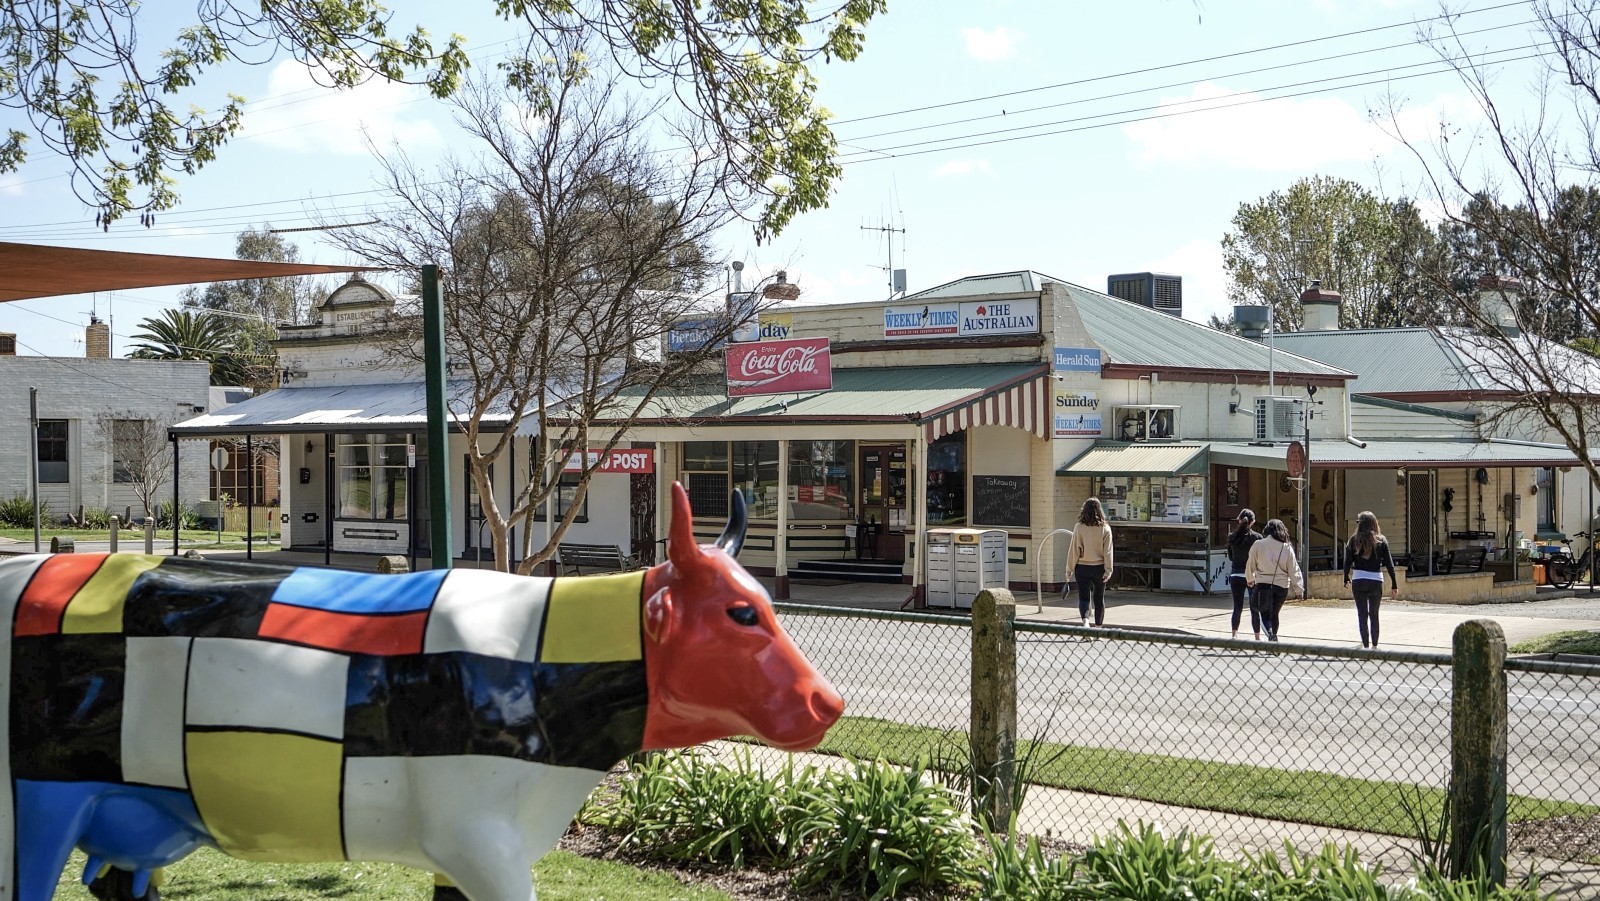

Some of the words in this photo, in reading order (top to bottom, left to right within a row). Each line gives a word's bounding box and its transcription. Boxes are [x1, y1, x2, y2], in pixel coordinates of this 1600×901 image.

[988, 304, 1011, 316] THE
[885, 312, 922, 328] WEEKLY
[929, 311, 958, 326] TIMES
[963, 315, 1034, 331] AUSTRALIAN
[1055, 354, 1083, 365] Herald
[1083, 354, 1099, 366] Sun
[1056, 396, 1099, 410] Sunday
[1055, 418, 1079, 429] WEEKLY
[1083, 418, 1101, 429] TIMES
[613, 453, 648, 469] POST
[985, 477, 1017, 489] Takeaway
